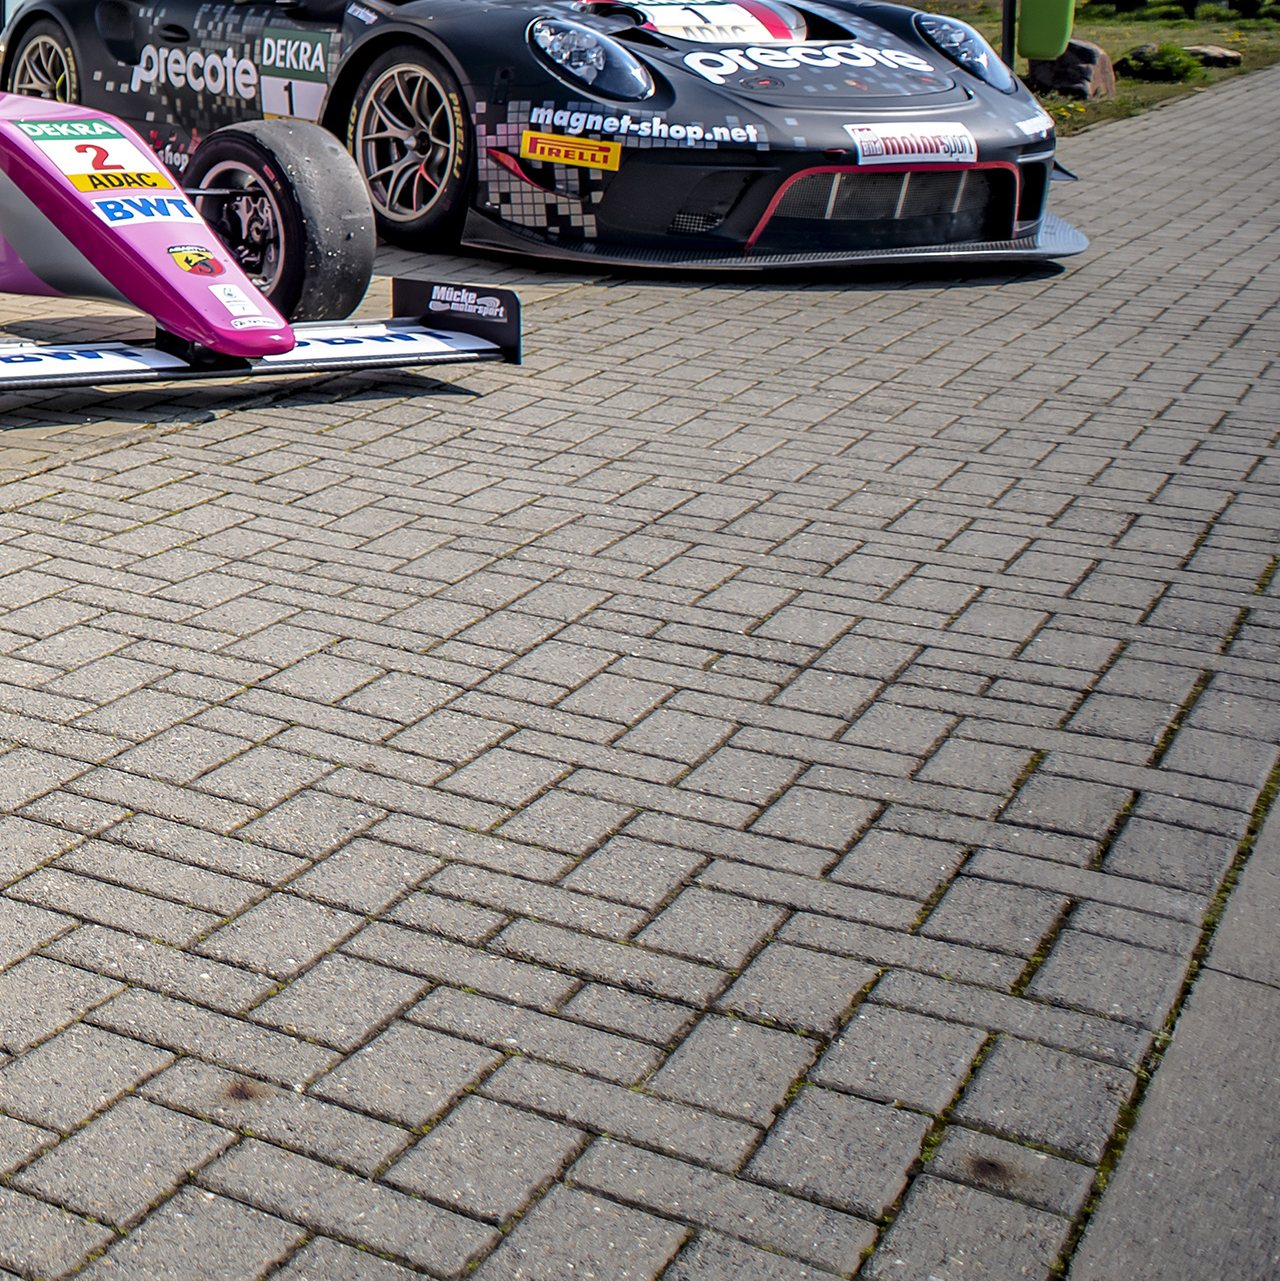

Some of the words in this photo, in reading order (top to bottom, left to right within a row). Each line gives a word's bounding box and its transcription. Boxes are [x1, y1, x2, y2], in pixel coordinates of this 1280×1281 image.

[262, 38, 326, 73] DEKRA
[682, 42, 935, 85] precote
[130, 44, 258, 99] precote
[282, 81, 295, 116] 1
[17, 122, 119, 136] DEKRA
[449, 93, 464, 178] PIRELLI
[530, 106, 758, 147] magnet-shop.net
[74, 144, 125, 170] 2
[528, 137, 611, 164] PIRELLI
[87, 173, 158, 189] ADAC
[95, 198, 194, 221] BWT
[431, 285, 478, 304] Mücke
[450, 302, 505, 317] motorsport
